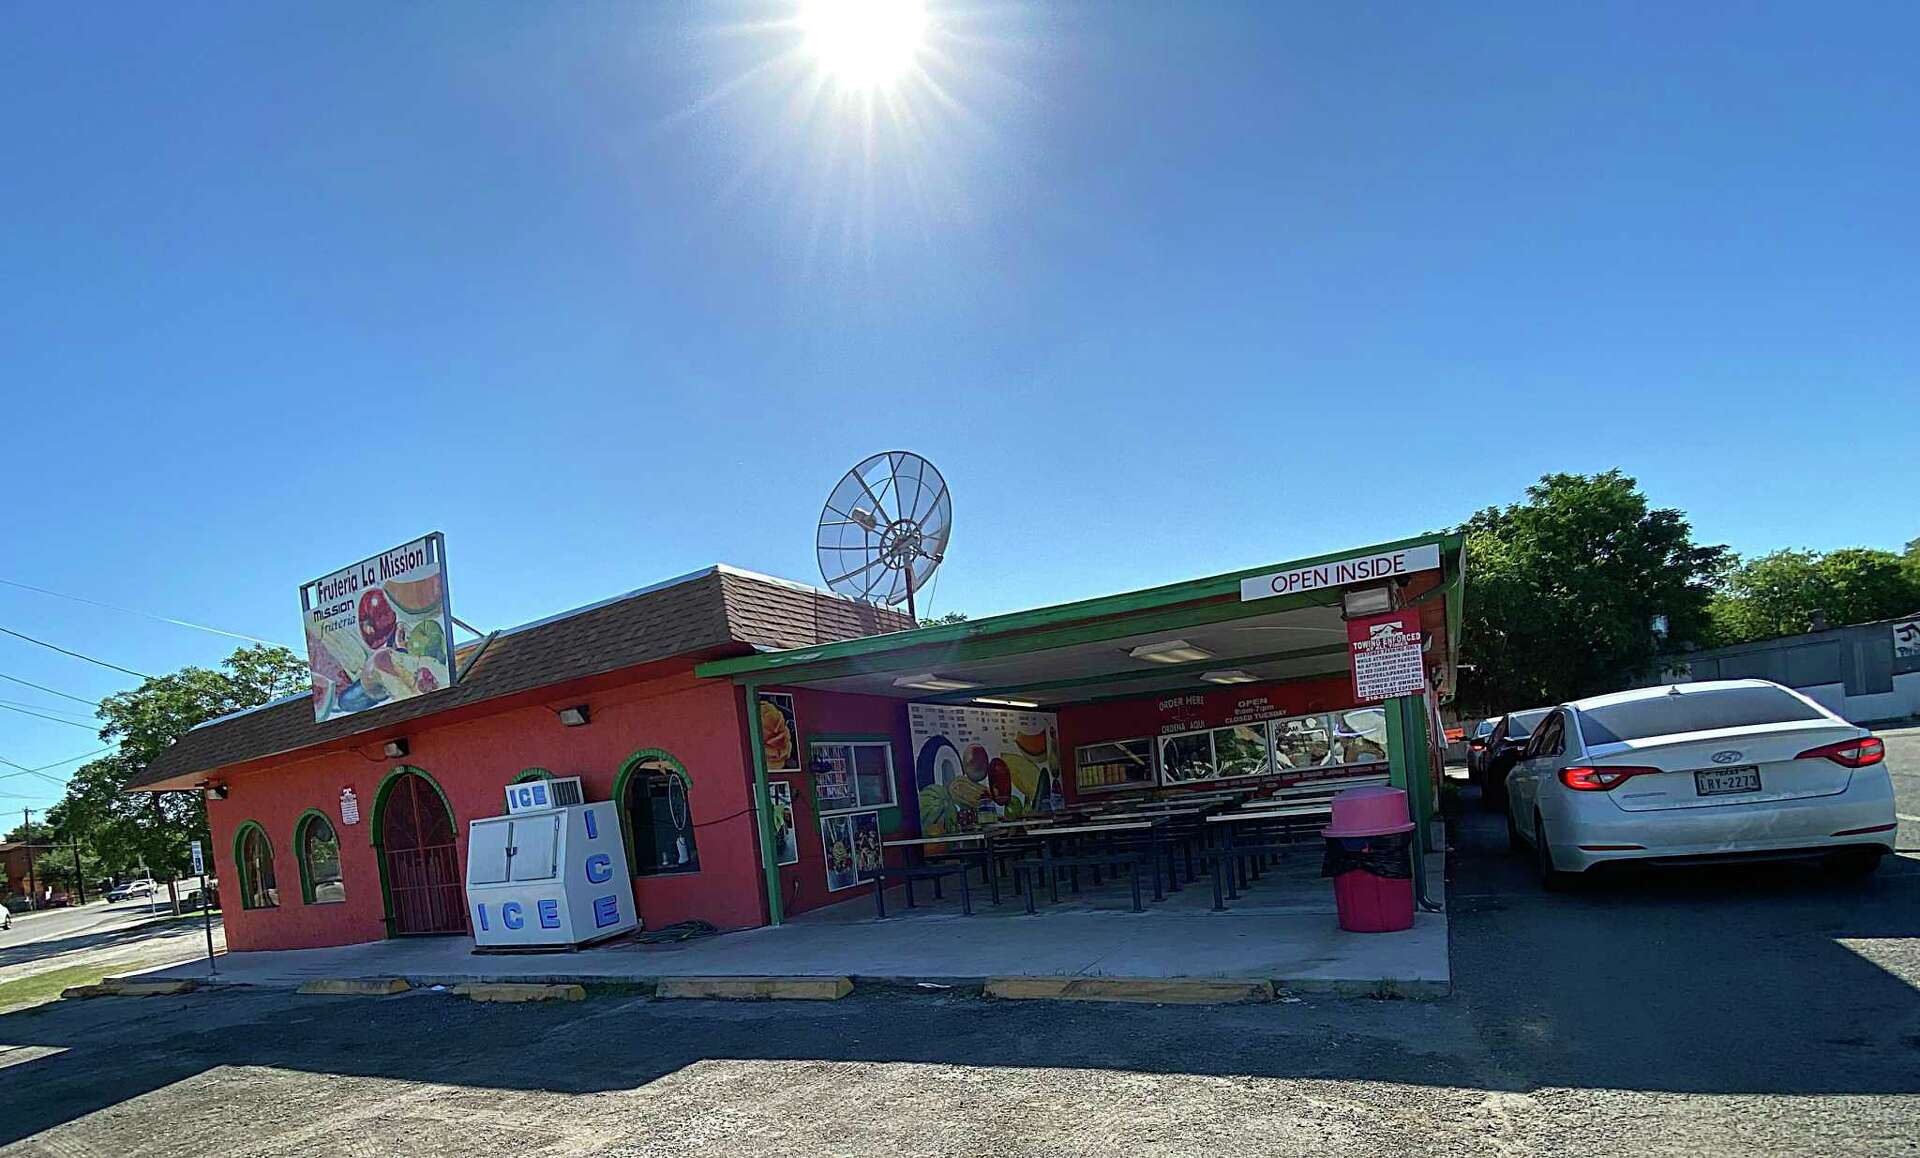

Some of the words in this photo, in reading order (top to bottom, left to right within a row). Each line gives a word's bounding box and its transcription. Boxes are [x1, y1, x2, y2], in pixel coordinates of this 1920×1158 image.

[317, 570, 358, 604] Fruteria
[361, 564, 375, 587] La
[379, 547, 424, 580] Mission
[1271, 567, 1329, 593] OPEN
[1336, 554, 1406, 584] INSIDE
[320, 615, 356, 639] fruteria
[1353, 639, 1379, 649] TOWING
[1382, 632, 1420, 645] ENFORCED
[1372, 652, 1400, 662] ATTENDING
[1159, 697, 1183, 711] ORDER
[1238, 698, 1268, 707] OPEN
[1254, 710, 1287, 719] TUESDAY
[509, 785, 547, 808] ICE
[584, 810, 620, 929] ICE
[478, 899, 560, 931] ICE
